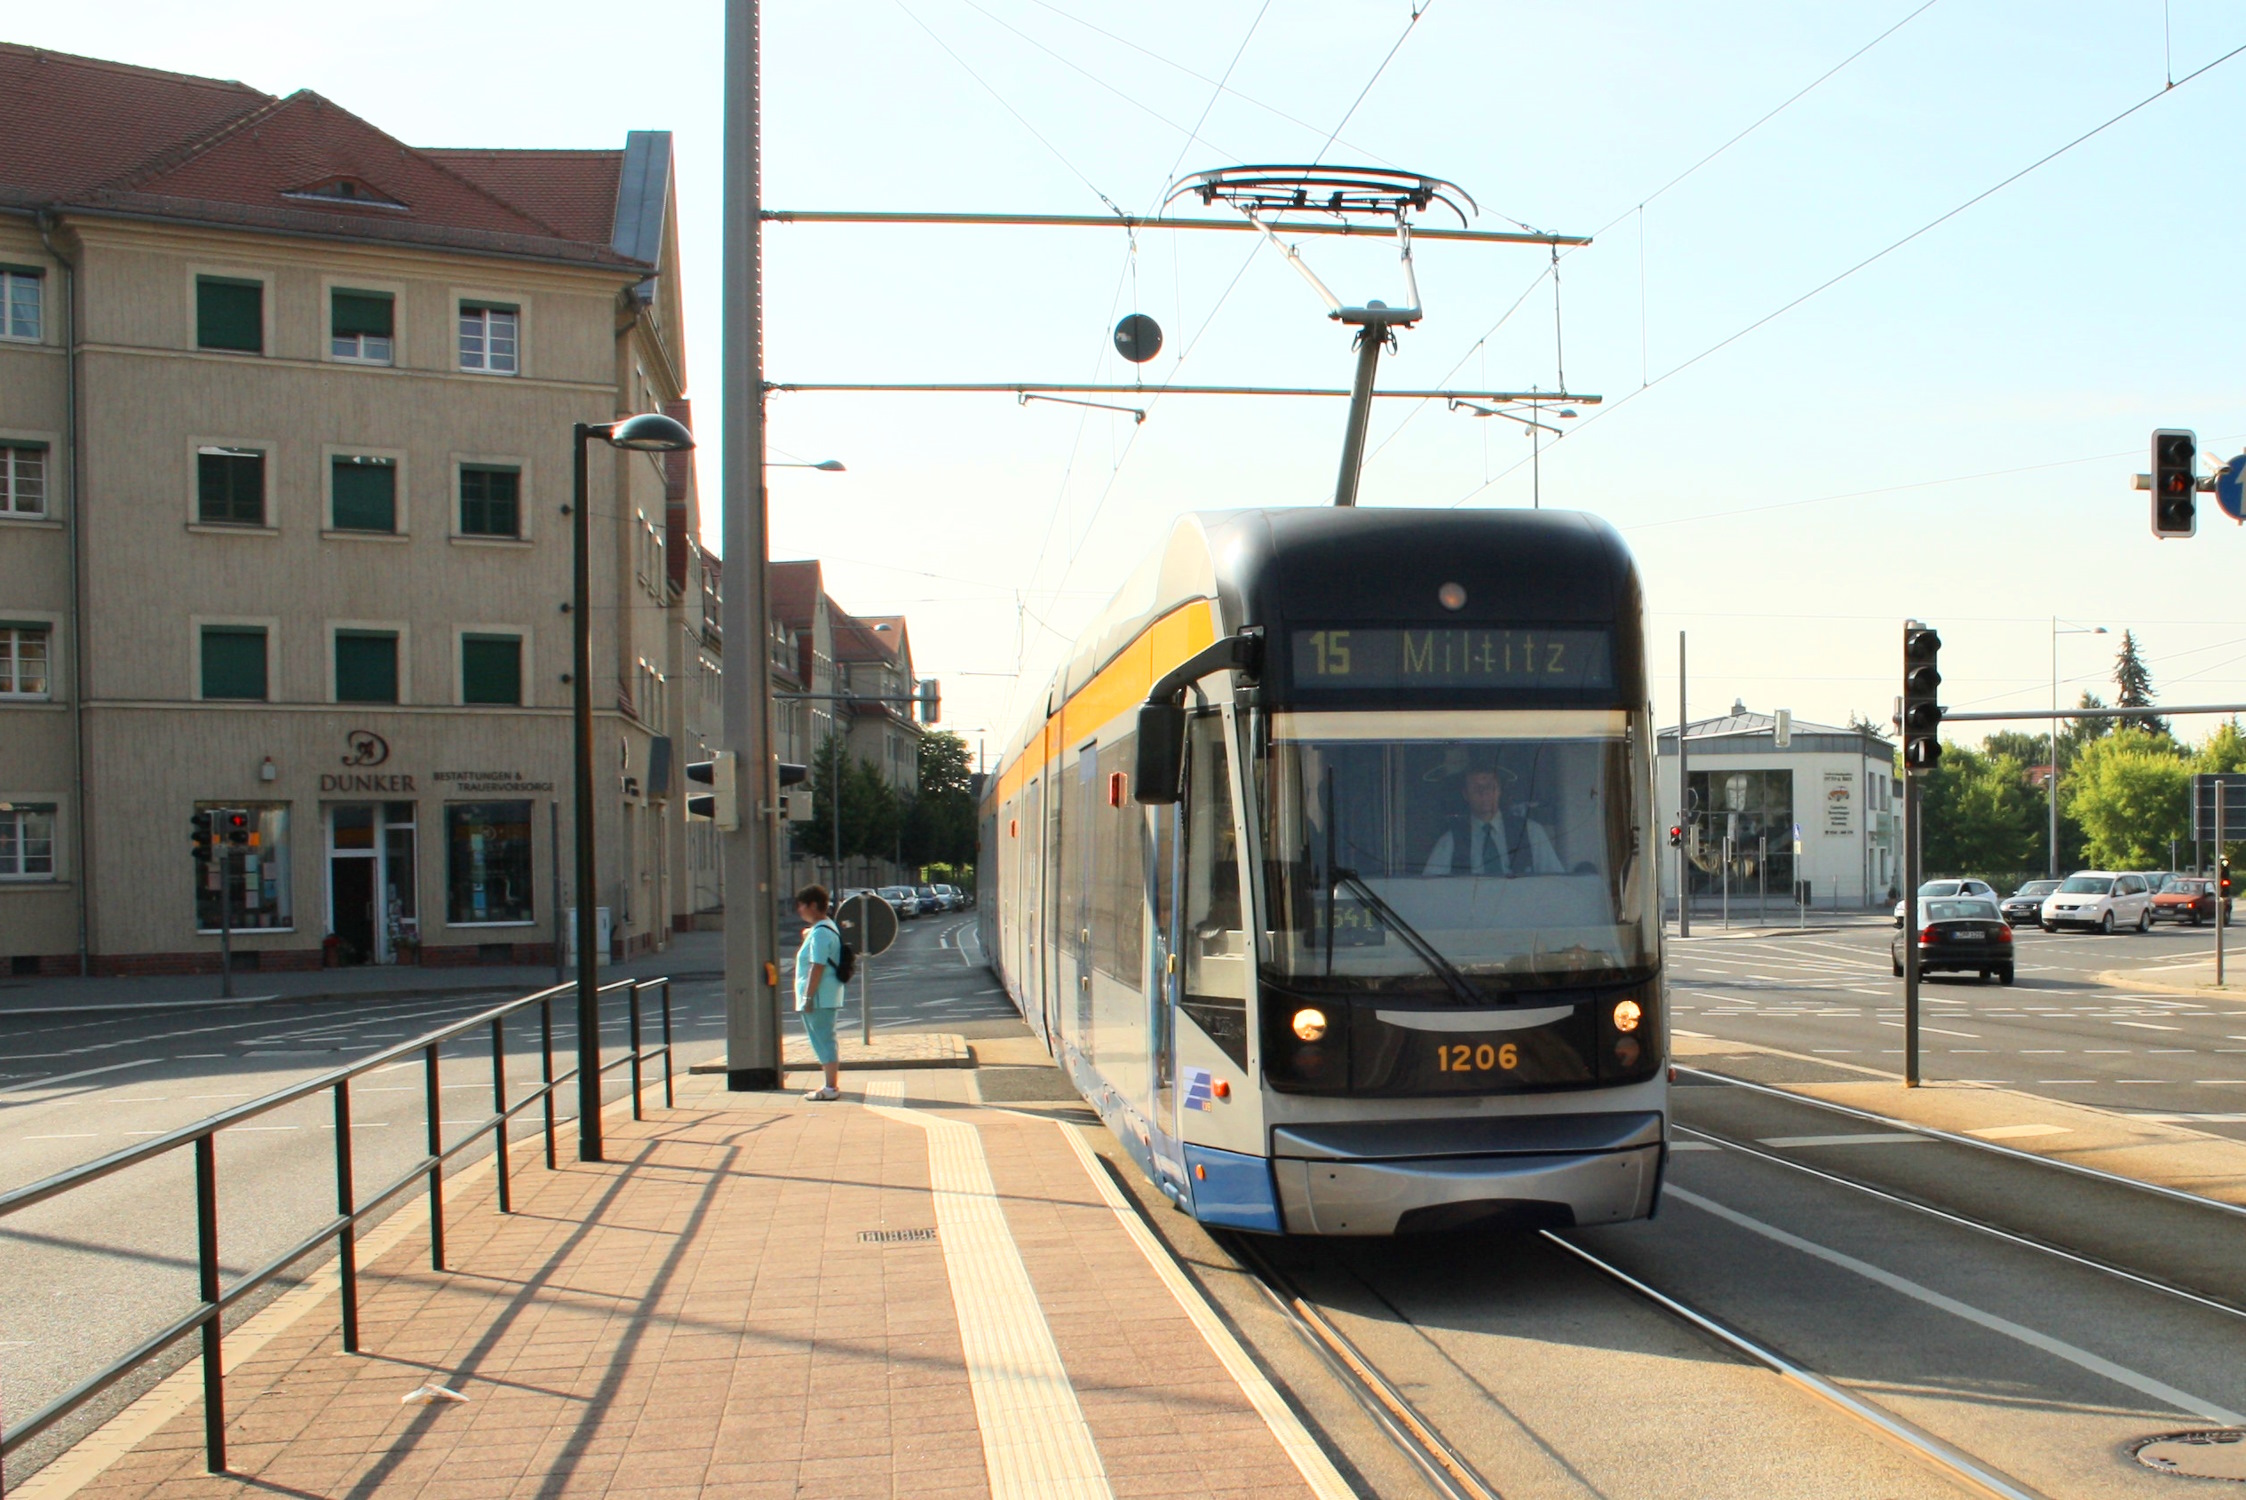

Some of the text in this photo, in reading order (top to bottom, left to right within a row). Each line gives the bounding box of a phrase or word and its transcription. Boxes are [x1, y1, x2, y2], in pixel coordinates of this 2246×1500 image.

[1309, 630, 1565, 675] 15 Miltitz
[320, 773, 417, 793] DUNKER
[433, 771, 522, 782] BESTATTUNGEN &
[457, 782, 554, 793] TRAUERVORSORGE
[1437, 1043, 1518, 1072] 1206
